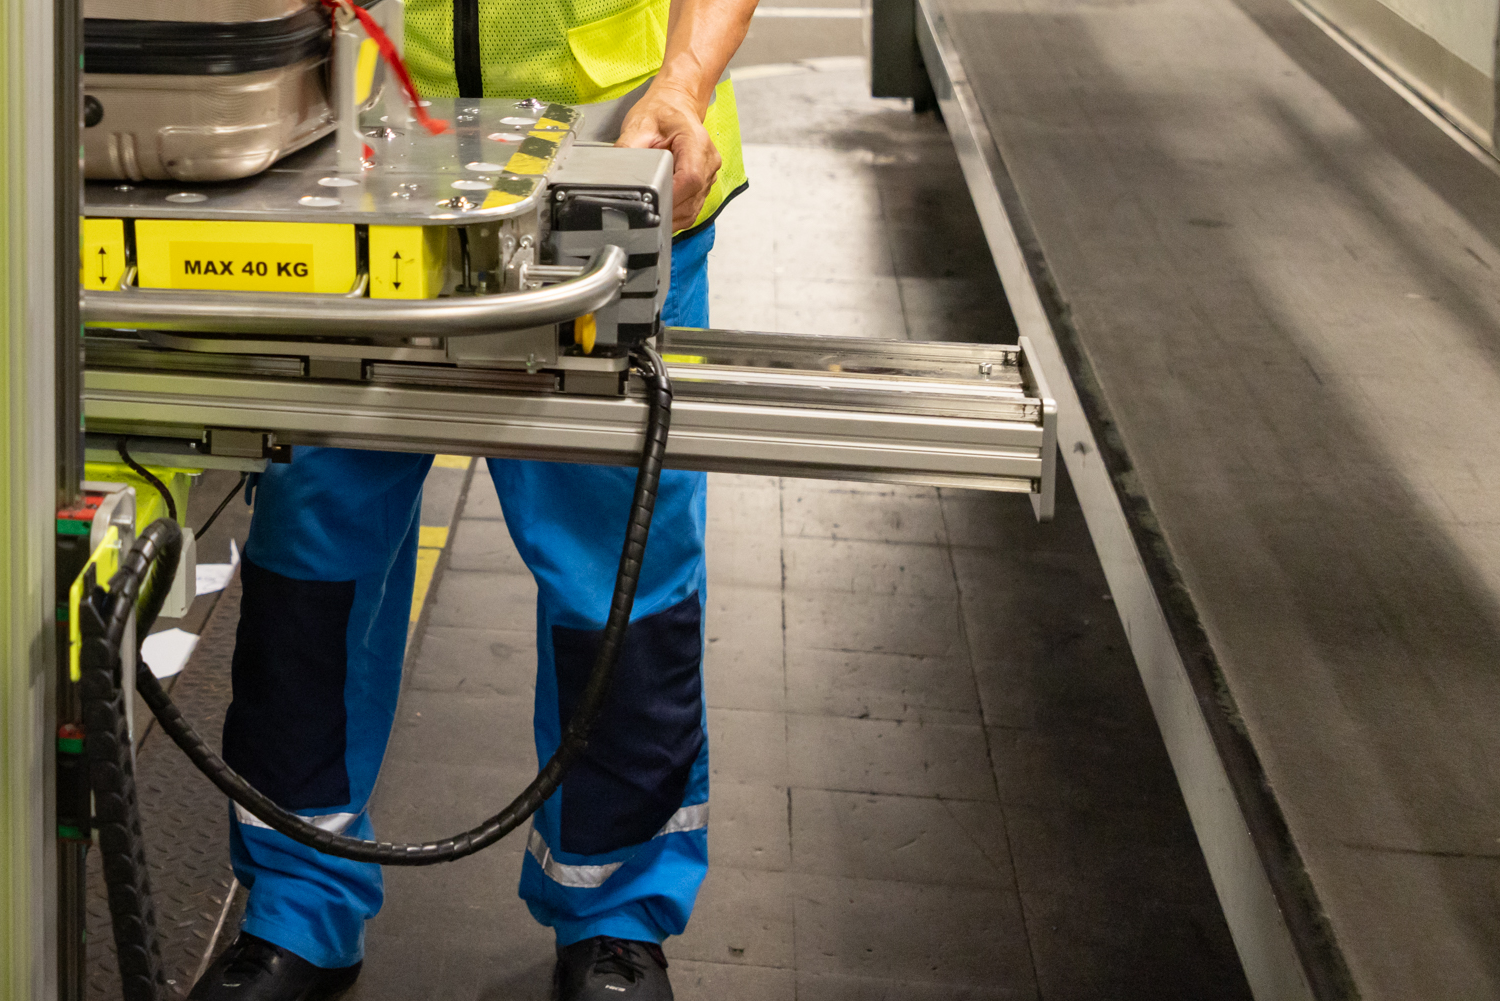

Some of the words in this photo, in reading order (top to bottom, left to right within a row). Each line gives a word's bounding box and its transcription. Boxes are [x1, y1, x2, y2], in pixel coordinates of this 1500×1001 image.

[184, 260, 234, 276] MAX
[241, 261, 268, 276] 40
[276, 262, 309, 277] KG
